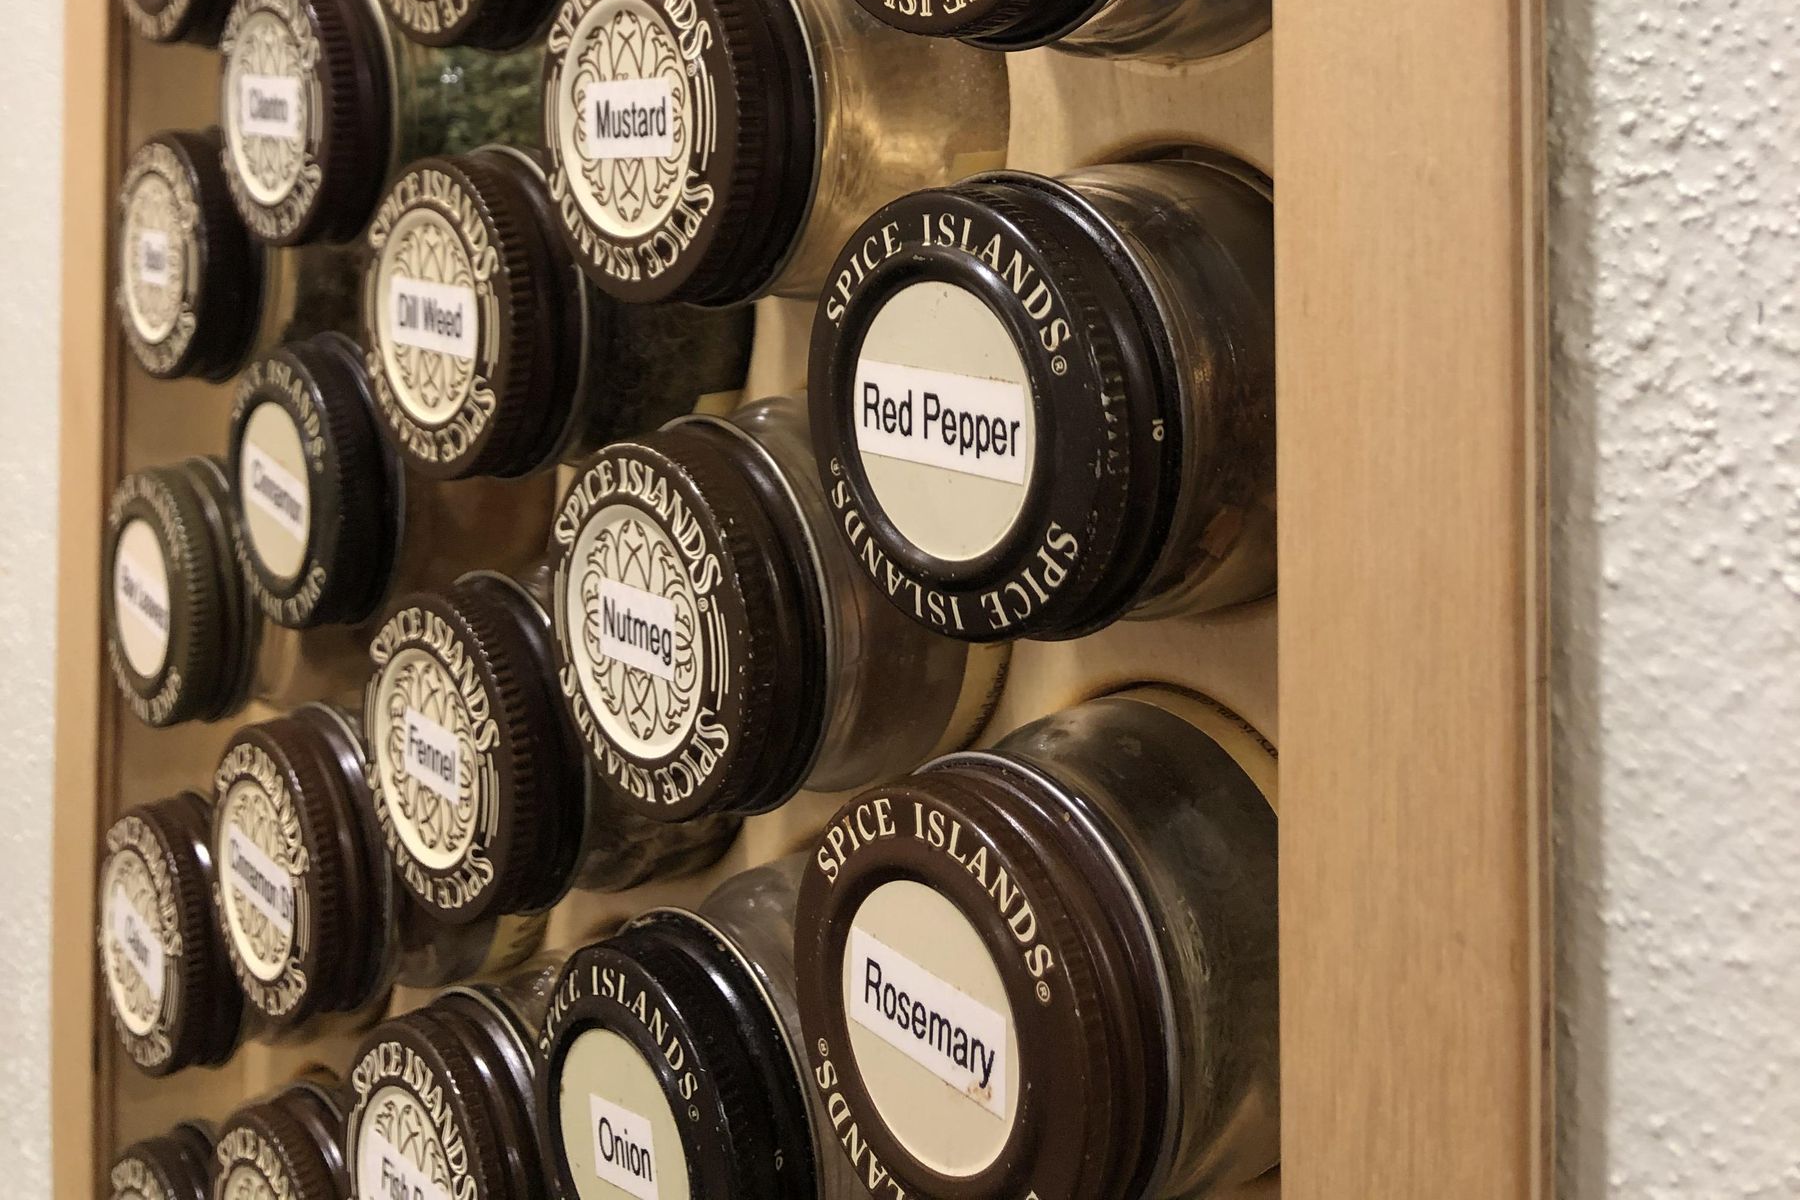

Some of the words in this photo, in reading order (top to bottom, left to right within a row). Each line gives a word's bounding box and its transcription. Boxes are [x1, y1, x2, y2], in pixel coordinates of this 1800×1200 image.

[596, 96, 667, 140] Mustard
[647, 168, 715, 279] SPICE
[826, 221, 903, 328] SPICE
[423, 297, 463, 338] Weed
[863, 381, 913, 437] Red
[924, 392, 1020, 459] Pepper
[554, 459, 617, 547] SPICE
[980, 521, 1079, 631] SPICE
[603, 595, 673, 667] Nutmeg
[408, 724, 456, 786] Fennel
[654, 709, 729, 805] SPICE
[817, 797, 896, 885] SPICE
[864, 956, 996, 1090] Rosemary
[352, 1041, 403, 1109] SPICE
[599, 1116, 654, 1183] Onion
